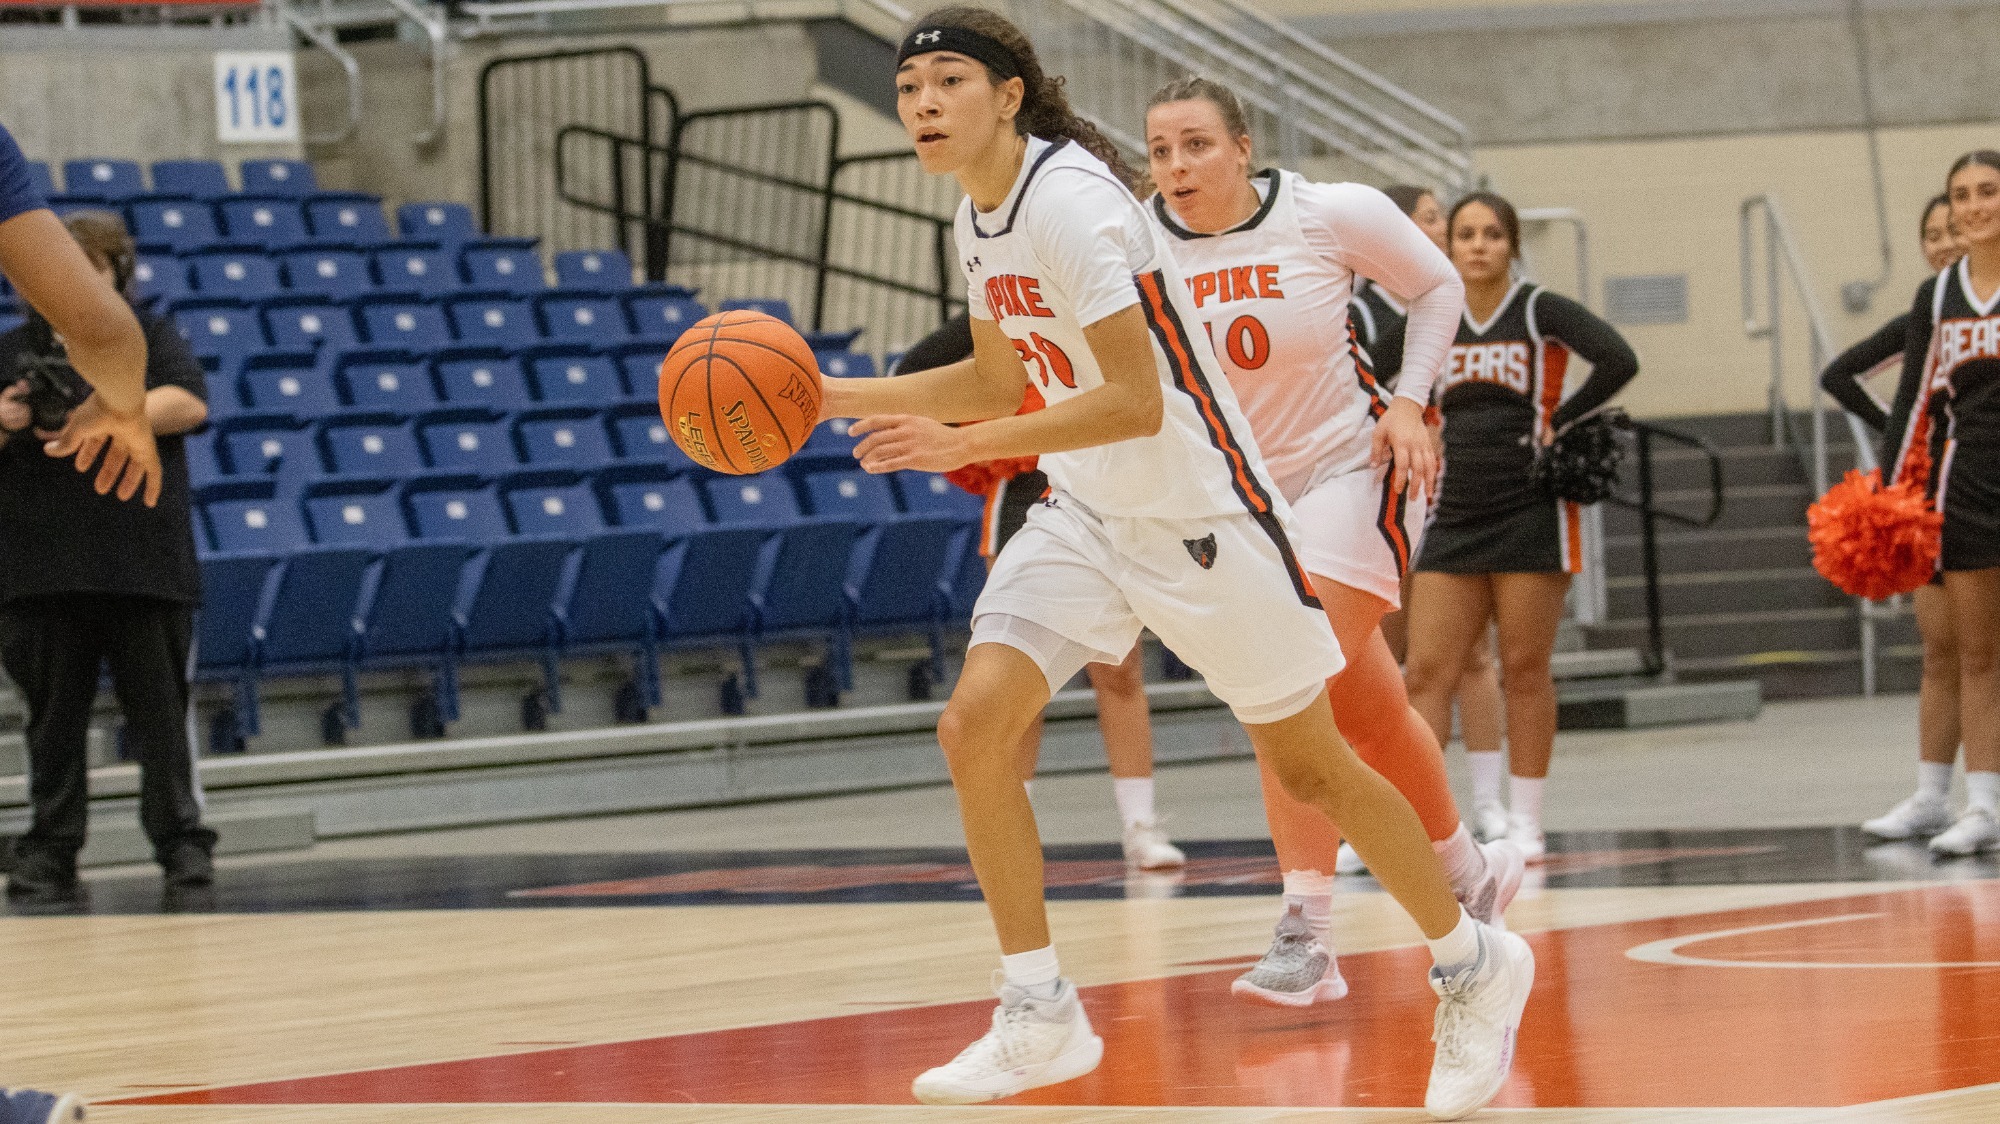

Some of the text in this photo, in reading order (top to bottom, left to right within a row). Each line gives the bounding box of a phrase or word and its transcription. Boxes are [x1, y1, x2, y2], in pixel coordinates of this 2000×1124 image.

[224, 65, 287, 128] 118
[1184, 264, 1285, 309] PIKE
[1203, 314, 1270, 375] 0
[1437, 342, 1530, 394] EARS
[1940, 317, 2000, 372] BEAR
[688, 411, 722, 469] LEGA
[720, 400, 774, 471] SPALDIN
